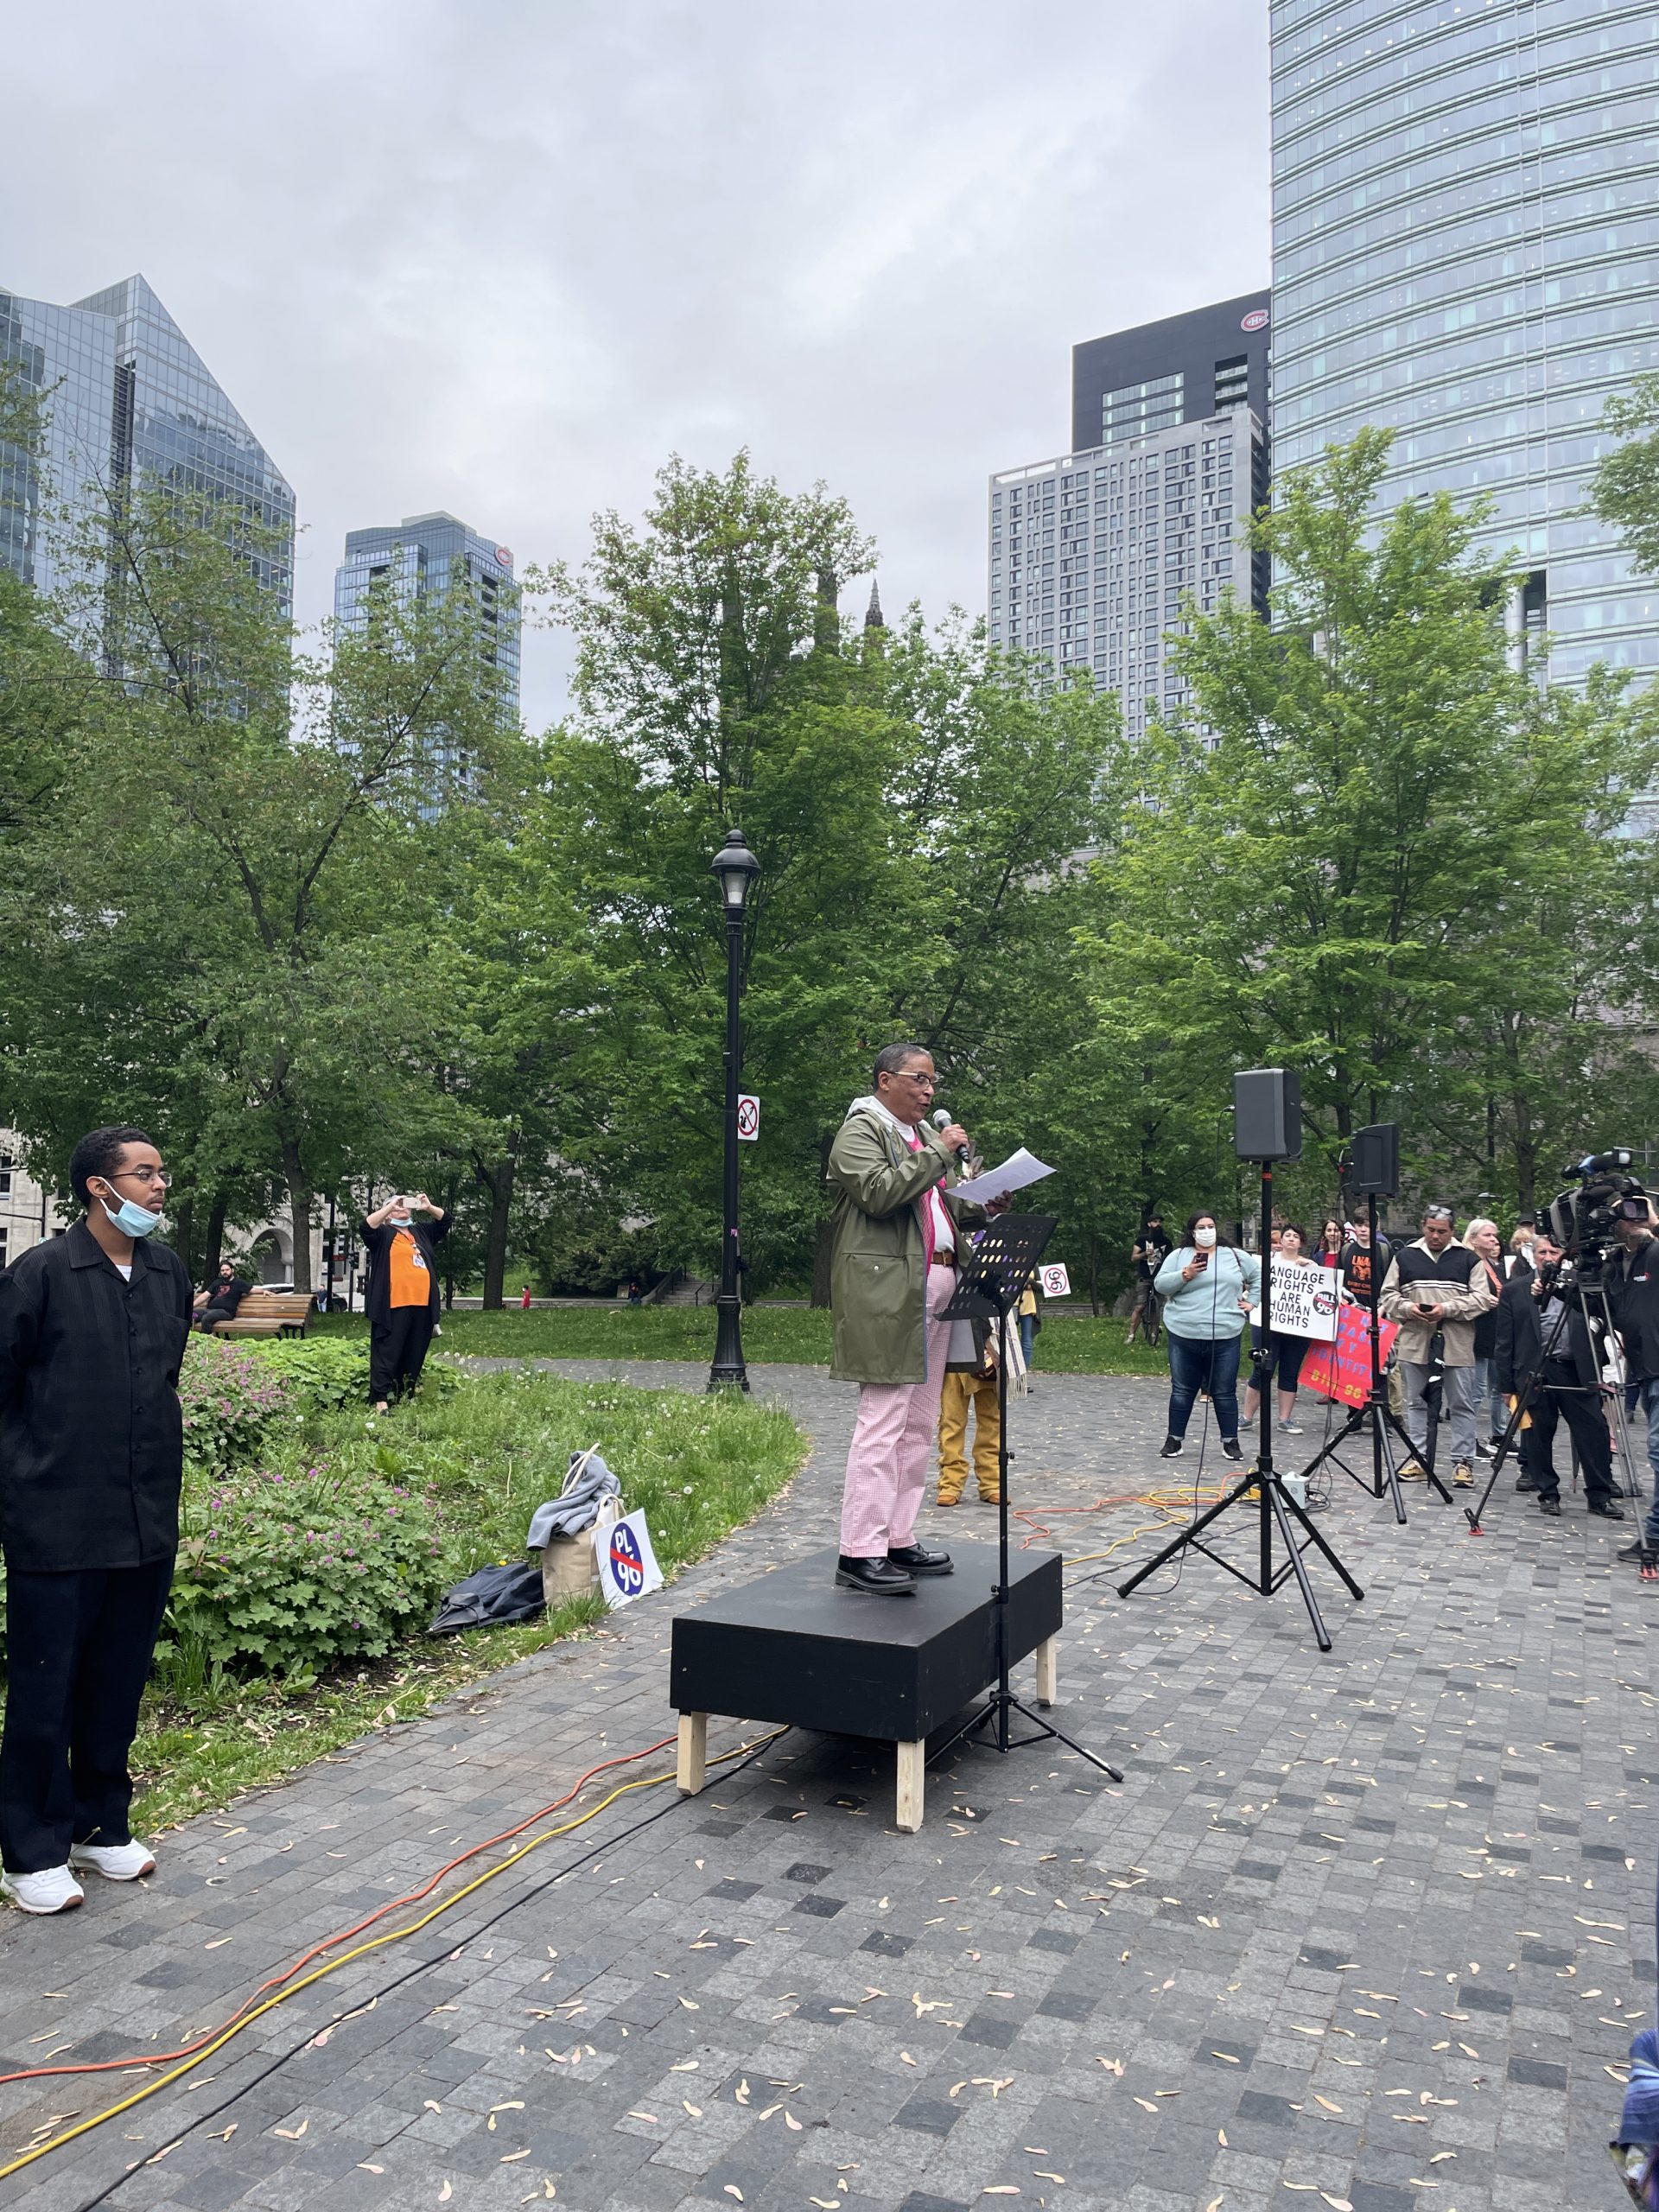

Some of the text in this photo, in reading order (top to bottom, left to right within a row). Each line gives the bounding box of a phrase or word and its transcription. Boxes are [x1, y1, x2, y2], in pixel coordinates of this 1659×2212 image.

[1270, 1265, 1325, 1284] ANGUAGE
[1270, 1276, 1314, 1294] RIGHTS
[1280, 1291, 1302, 1305] ARE
[1270, 1300, 1311, 1317] HUMAN
[614, 1529, 633, 1554] PL
[617, 1554, 642, 1592] 96
